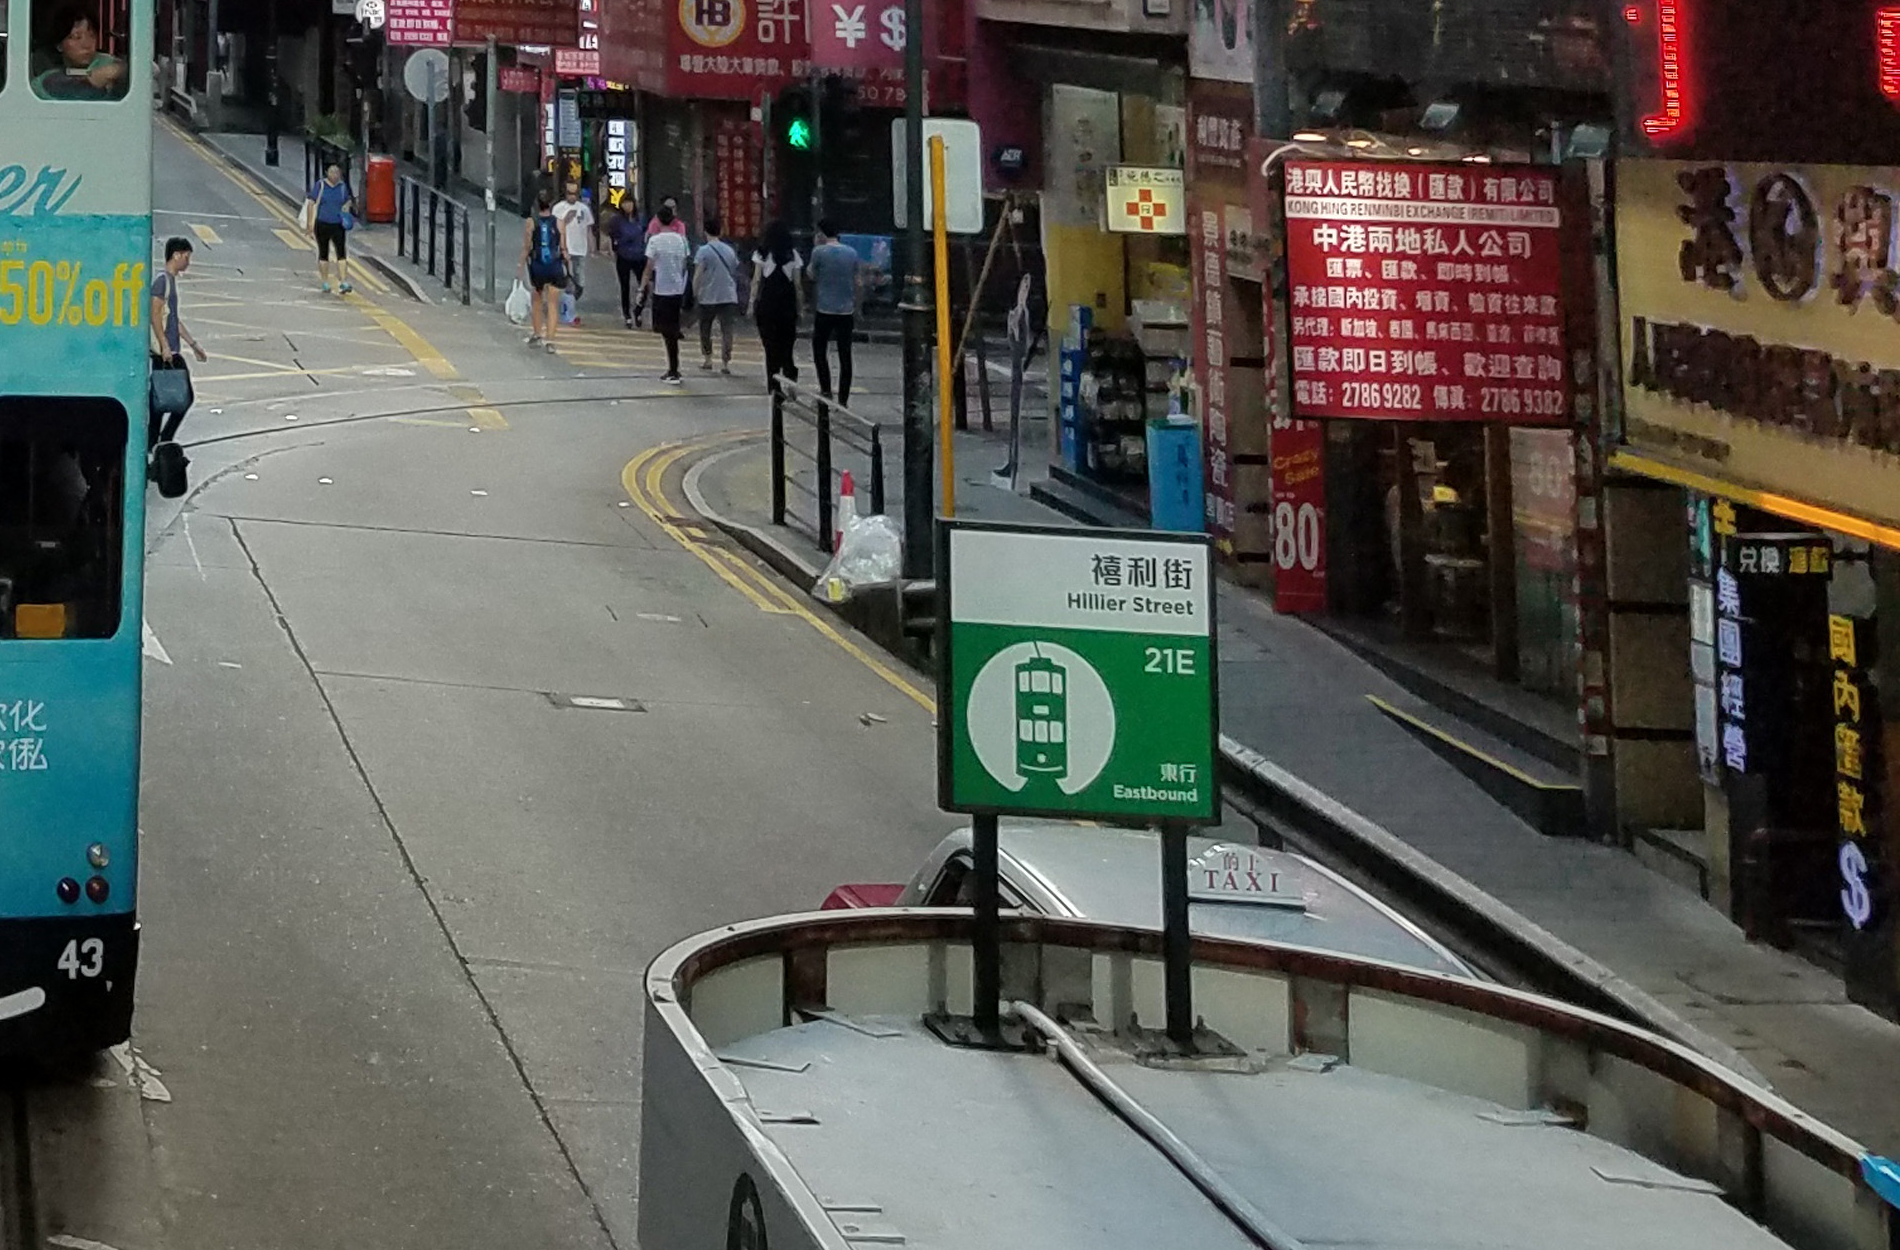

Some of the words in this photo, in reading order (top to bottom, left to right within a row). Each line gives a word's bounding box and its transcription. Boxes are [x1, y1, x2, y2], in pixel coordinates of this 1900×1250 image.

[1288, 201, 1318, 215] KONG
[1320, 202, 1348, 216] HING
[1351, 204, 1404, 218] RENMINBI
[1406, 206, 1466, 220] EXCHANGE
[1313, 223, 1532, 259] 中港兩地私人公司
[1342, 383, 1380, 408] 2786
[1383, 384, 1421, 409] 9282
[1091, 553, 1192, 589] 禧利街
[1067, 593, 1126, 611] Hillier
[1133, 597, 1194, 615] Street
[1144, 647, 1195, 674] 21E
[1160, 763, 1196, 783] 東行
[1113, 785, 1198, 802] Eastbound
[1204, 870, 1279, 892] TAXI
[57, 938, 103, 979] 43
